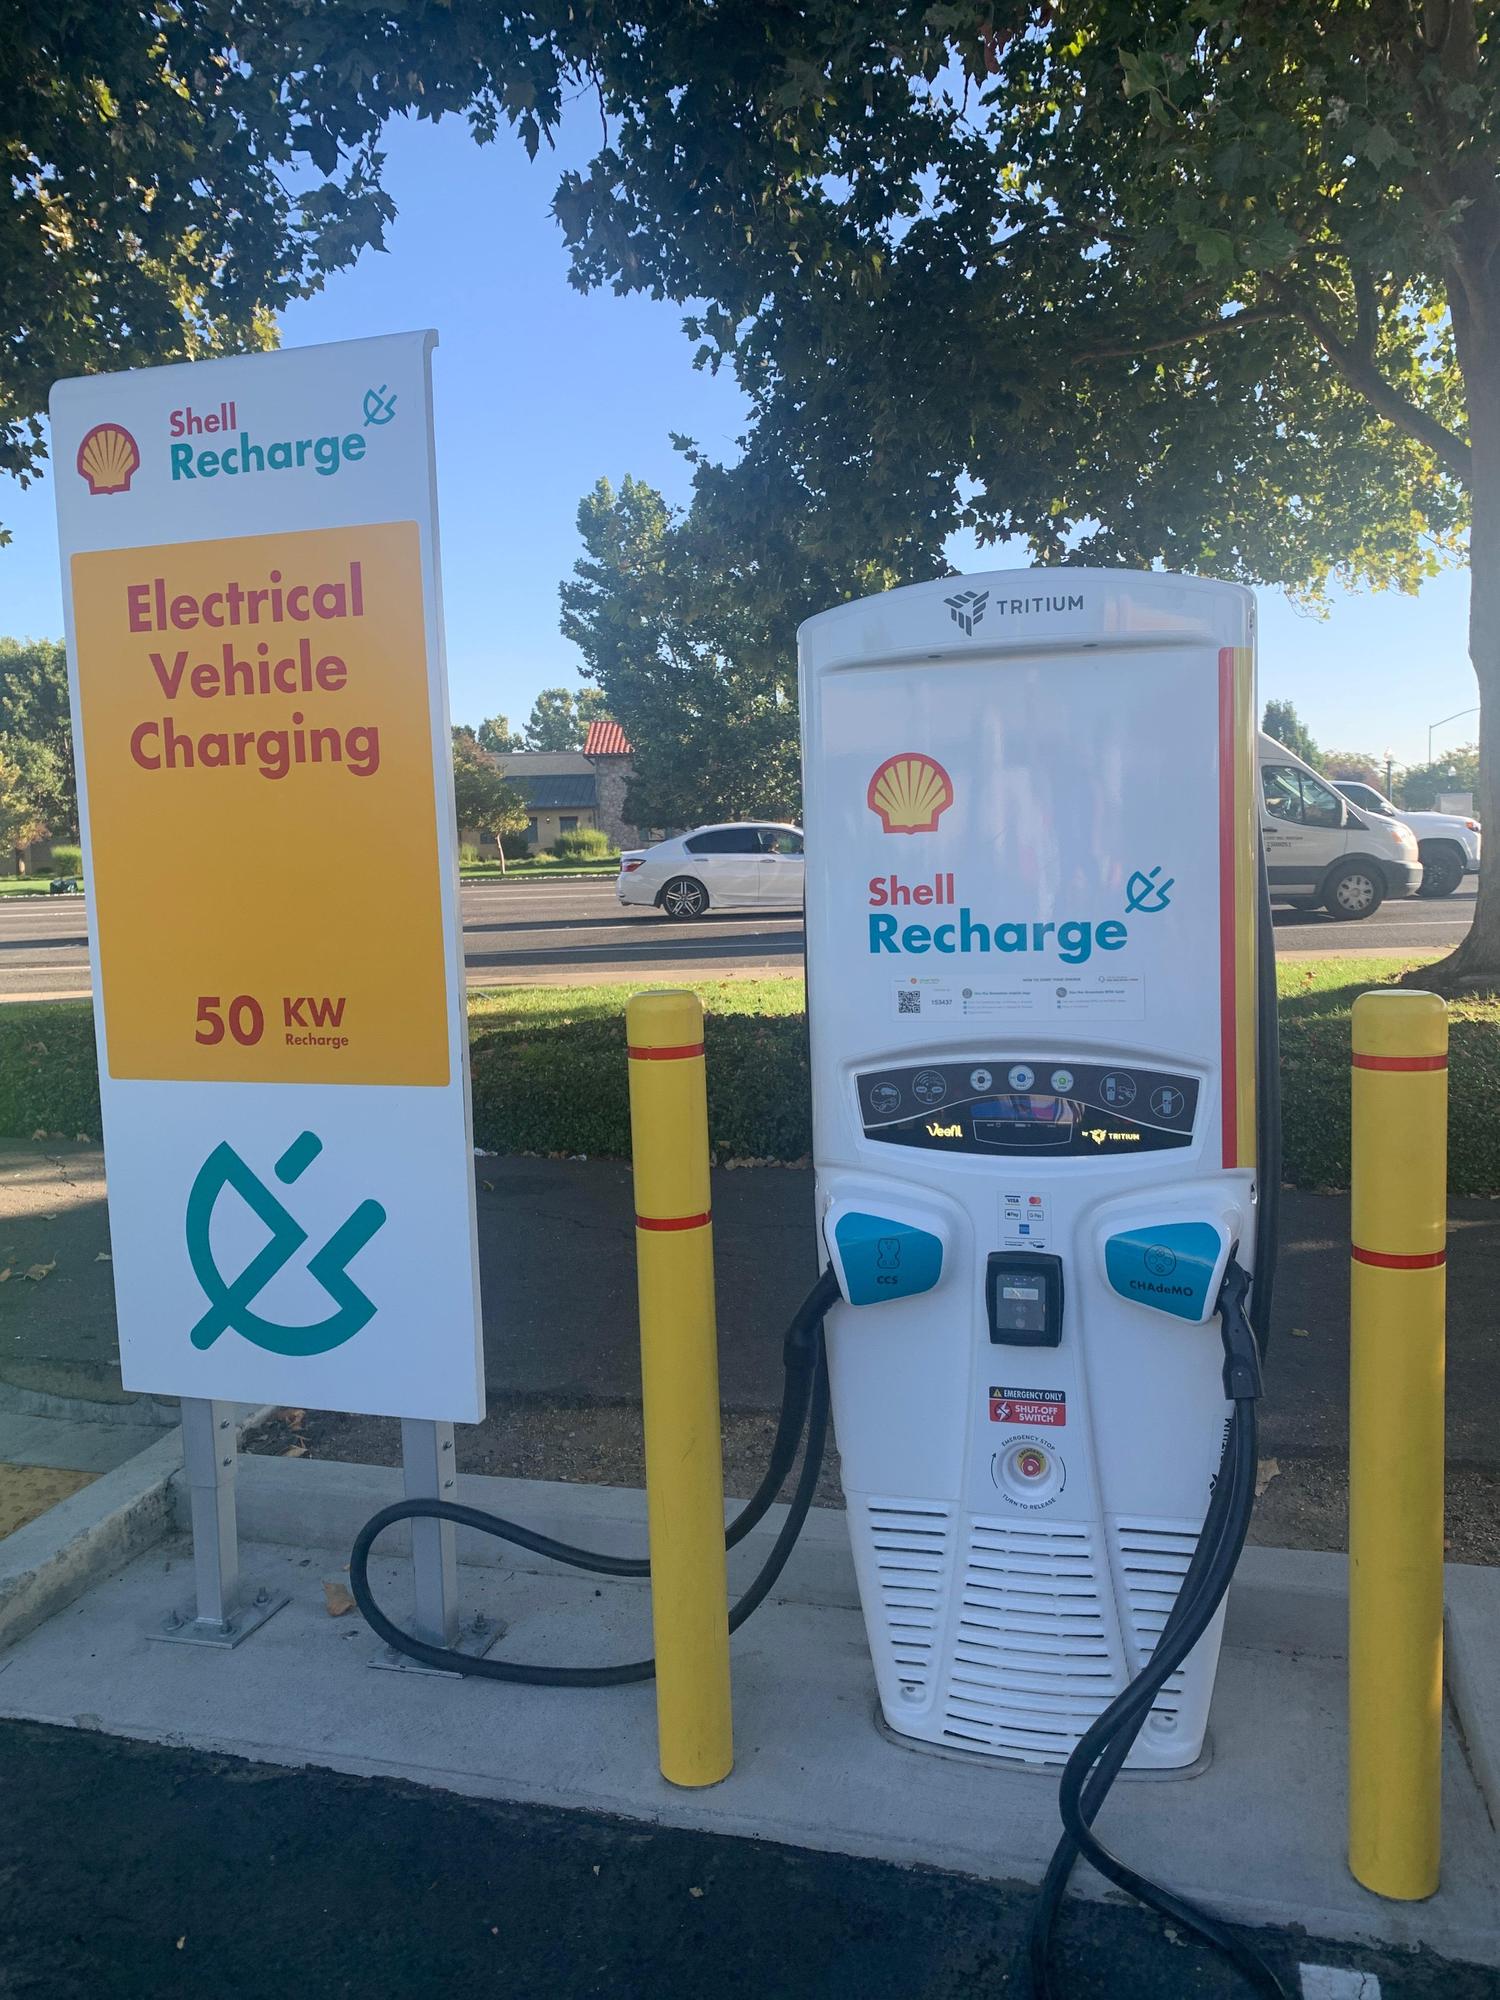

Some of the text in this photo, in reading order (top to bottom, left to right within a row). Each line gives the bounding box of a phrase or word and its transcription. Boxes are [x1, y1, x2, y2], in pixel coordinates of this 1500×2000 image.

[169, 402, 237, 437] Shell
[170, 432, 366, 480] Recharge
[127, 561, 364, 632] Electrical
[997, 595, 1084, 615] TRITIUM
[149, 638, 348, 699] Vehicle
[130, 711, 380, 779] Charging
[868, 873, 954, 906] Shell
[868, 908, 1127, 964] Recharge
[195, 995, 346, 1046] 50 KW
[285, 1033, 349, 1049] Recharge
[877, 1276, 898, 1285] CCS
[1130, 1280, 1193, 1296] CHAdeMO
[1004, 1389, 1063, 1401] EMERGENCY ONLY
[1015, 1404, 1058, 1415] SHUT-OFF
[1019, 1413, 1054, 1423] SWITCH
[1001, 1434, 1056, 1451] EMERGENCY STOP
[1002, 1494, 1018, 1507] TURN
[1029, 1497, 1056, 1510] RELEASE
